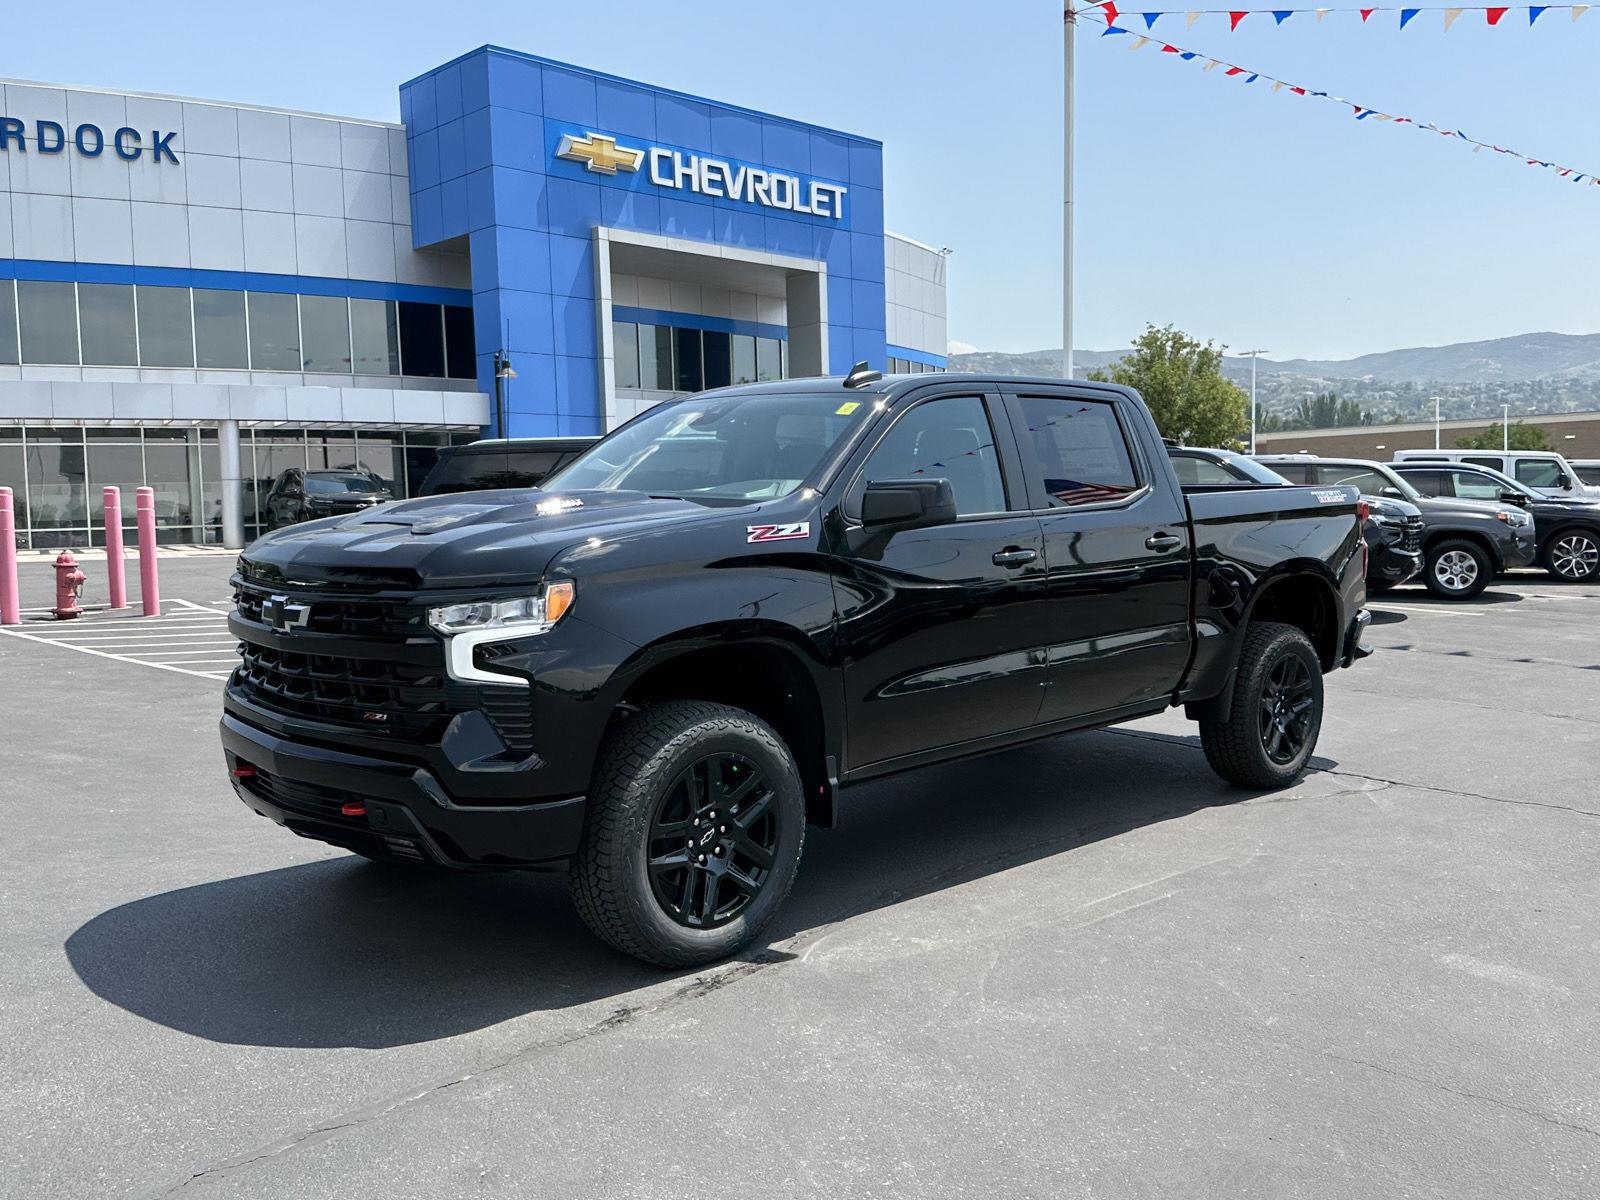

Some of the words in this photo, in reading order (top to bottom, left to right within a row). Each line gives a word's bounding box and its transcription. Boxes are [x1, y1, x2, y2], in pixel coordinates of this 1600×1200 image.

[0, 117, 180, 165] RDOCK
[650, 147, 848, 219] CHEVROLET
[747, 522, 810, 543] Z71
